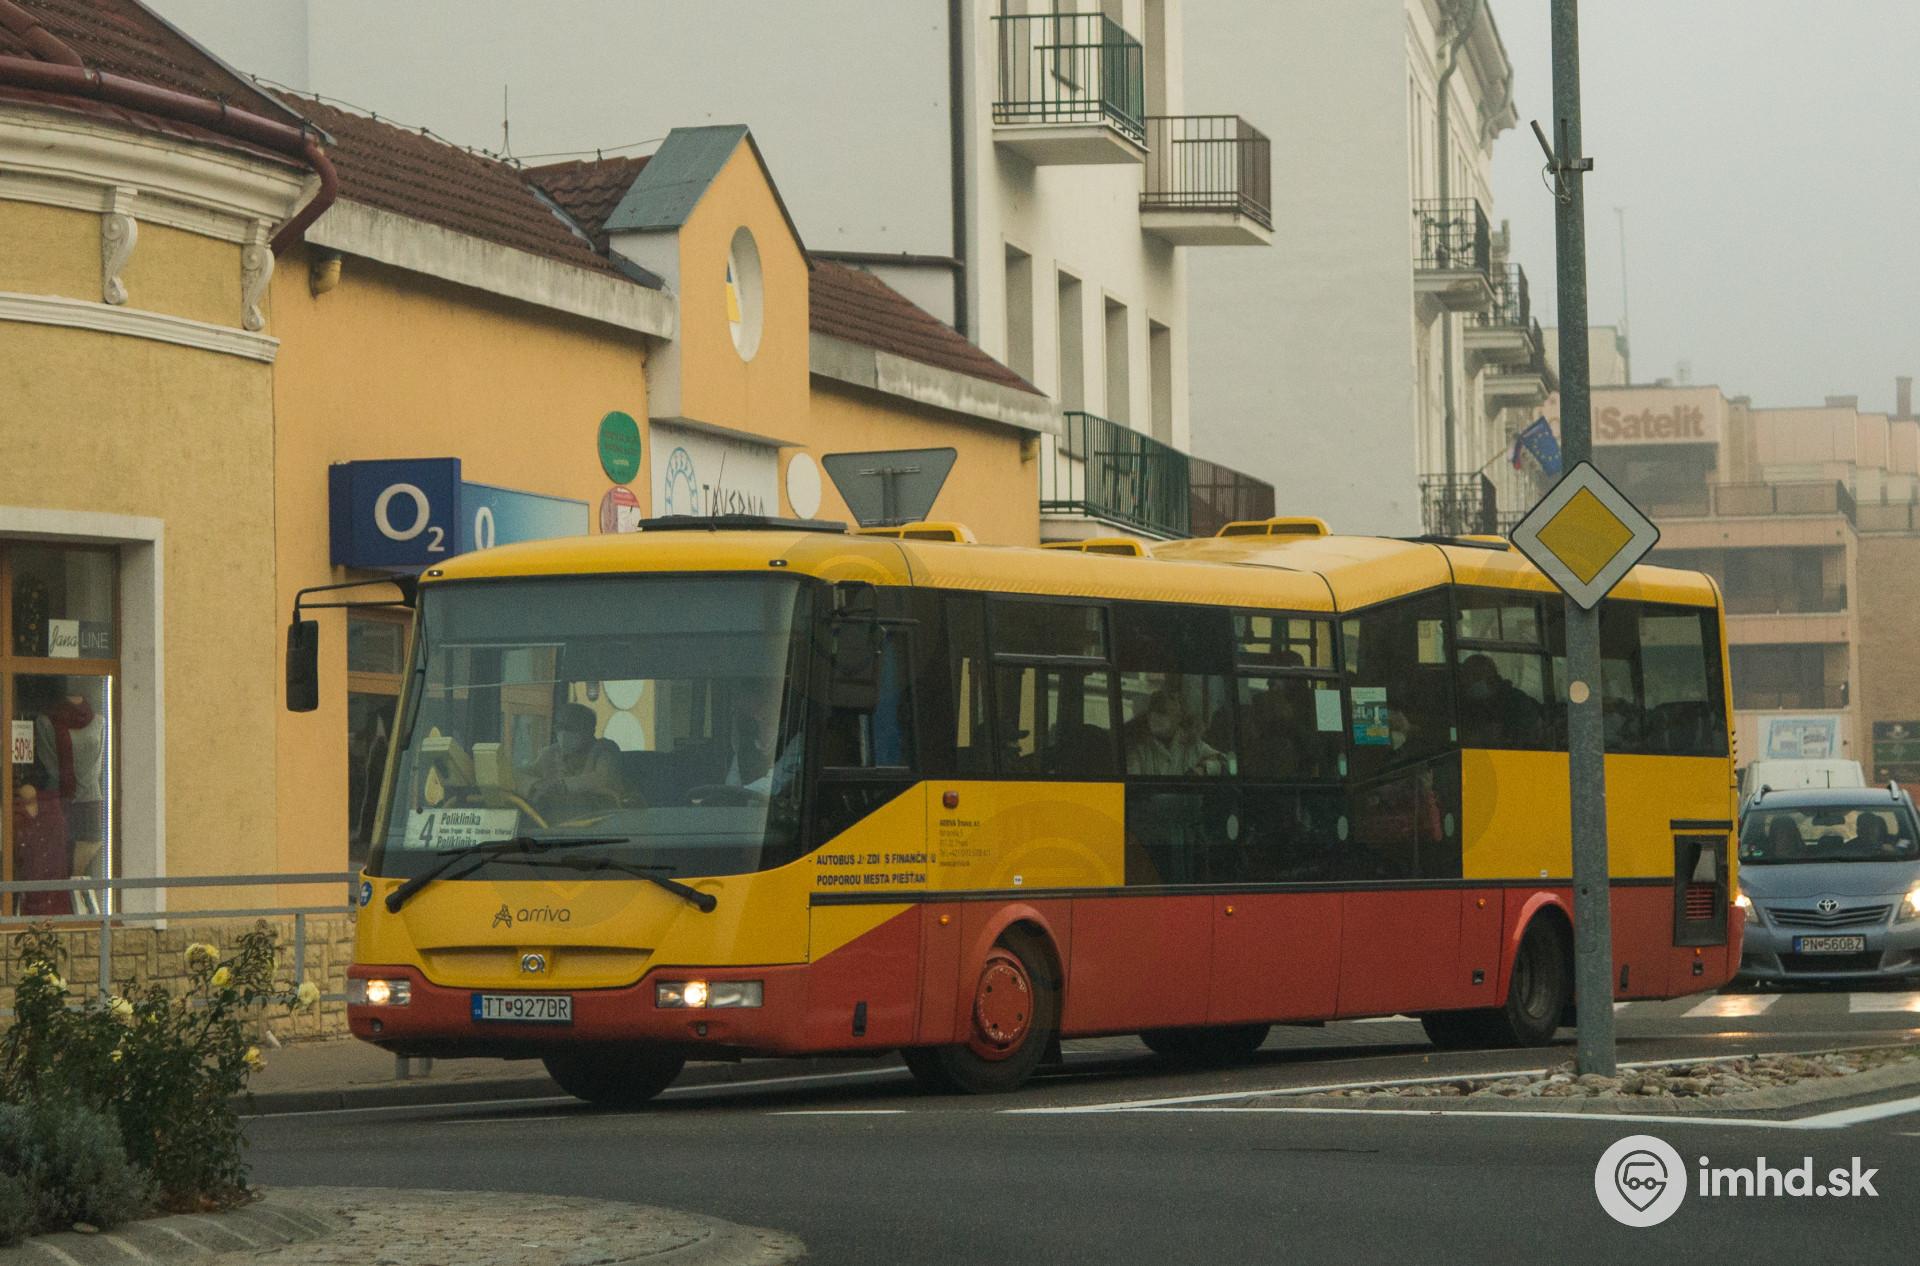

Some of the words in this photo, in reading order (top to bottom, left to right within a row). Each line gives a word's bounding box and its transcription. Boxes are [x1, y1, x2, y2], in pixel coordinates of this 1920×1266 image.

[1600, 404, 1704, 439] Satelit
[81, 631, 109, 649] LINE
[419, 814, 436, 848] 4
[441, 812, 481, 826] Poliklinika
[816, 854, 855, 865] AUTOBUS
[816, 874, 861, 886] PODPOROU
[863, 873, 889, 884] MESTA
[516, 904, 571, 922] arriva
[484, 998, 504, 1017] TT
